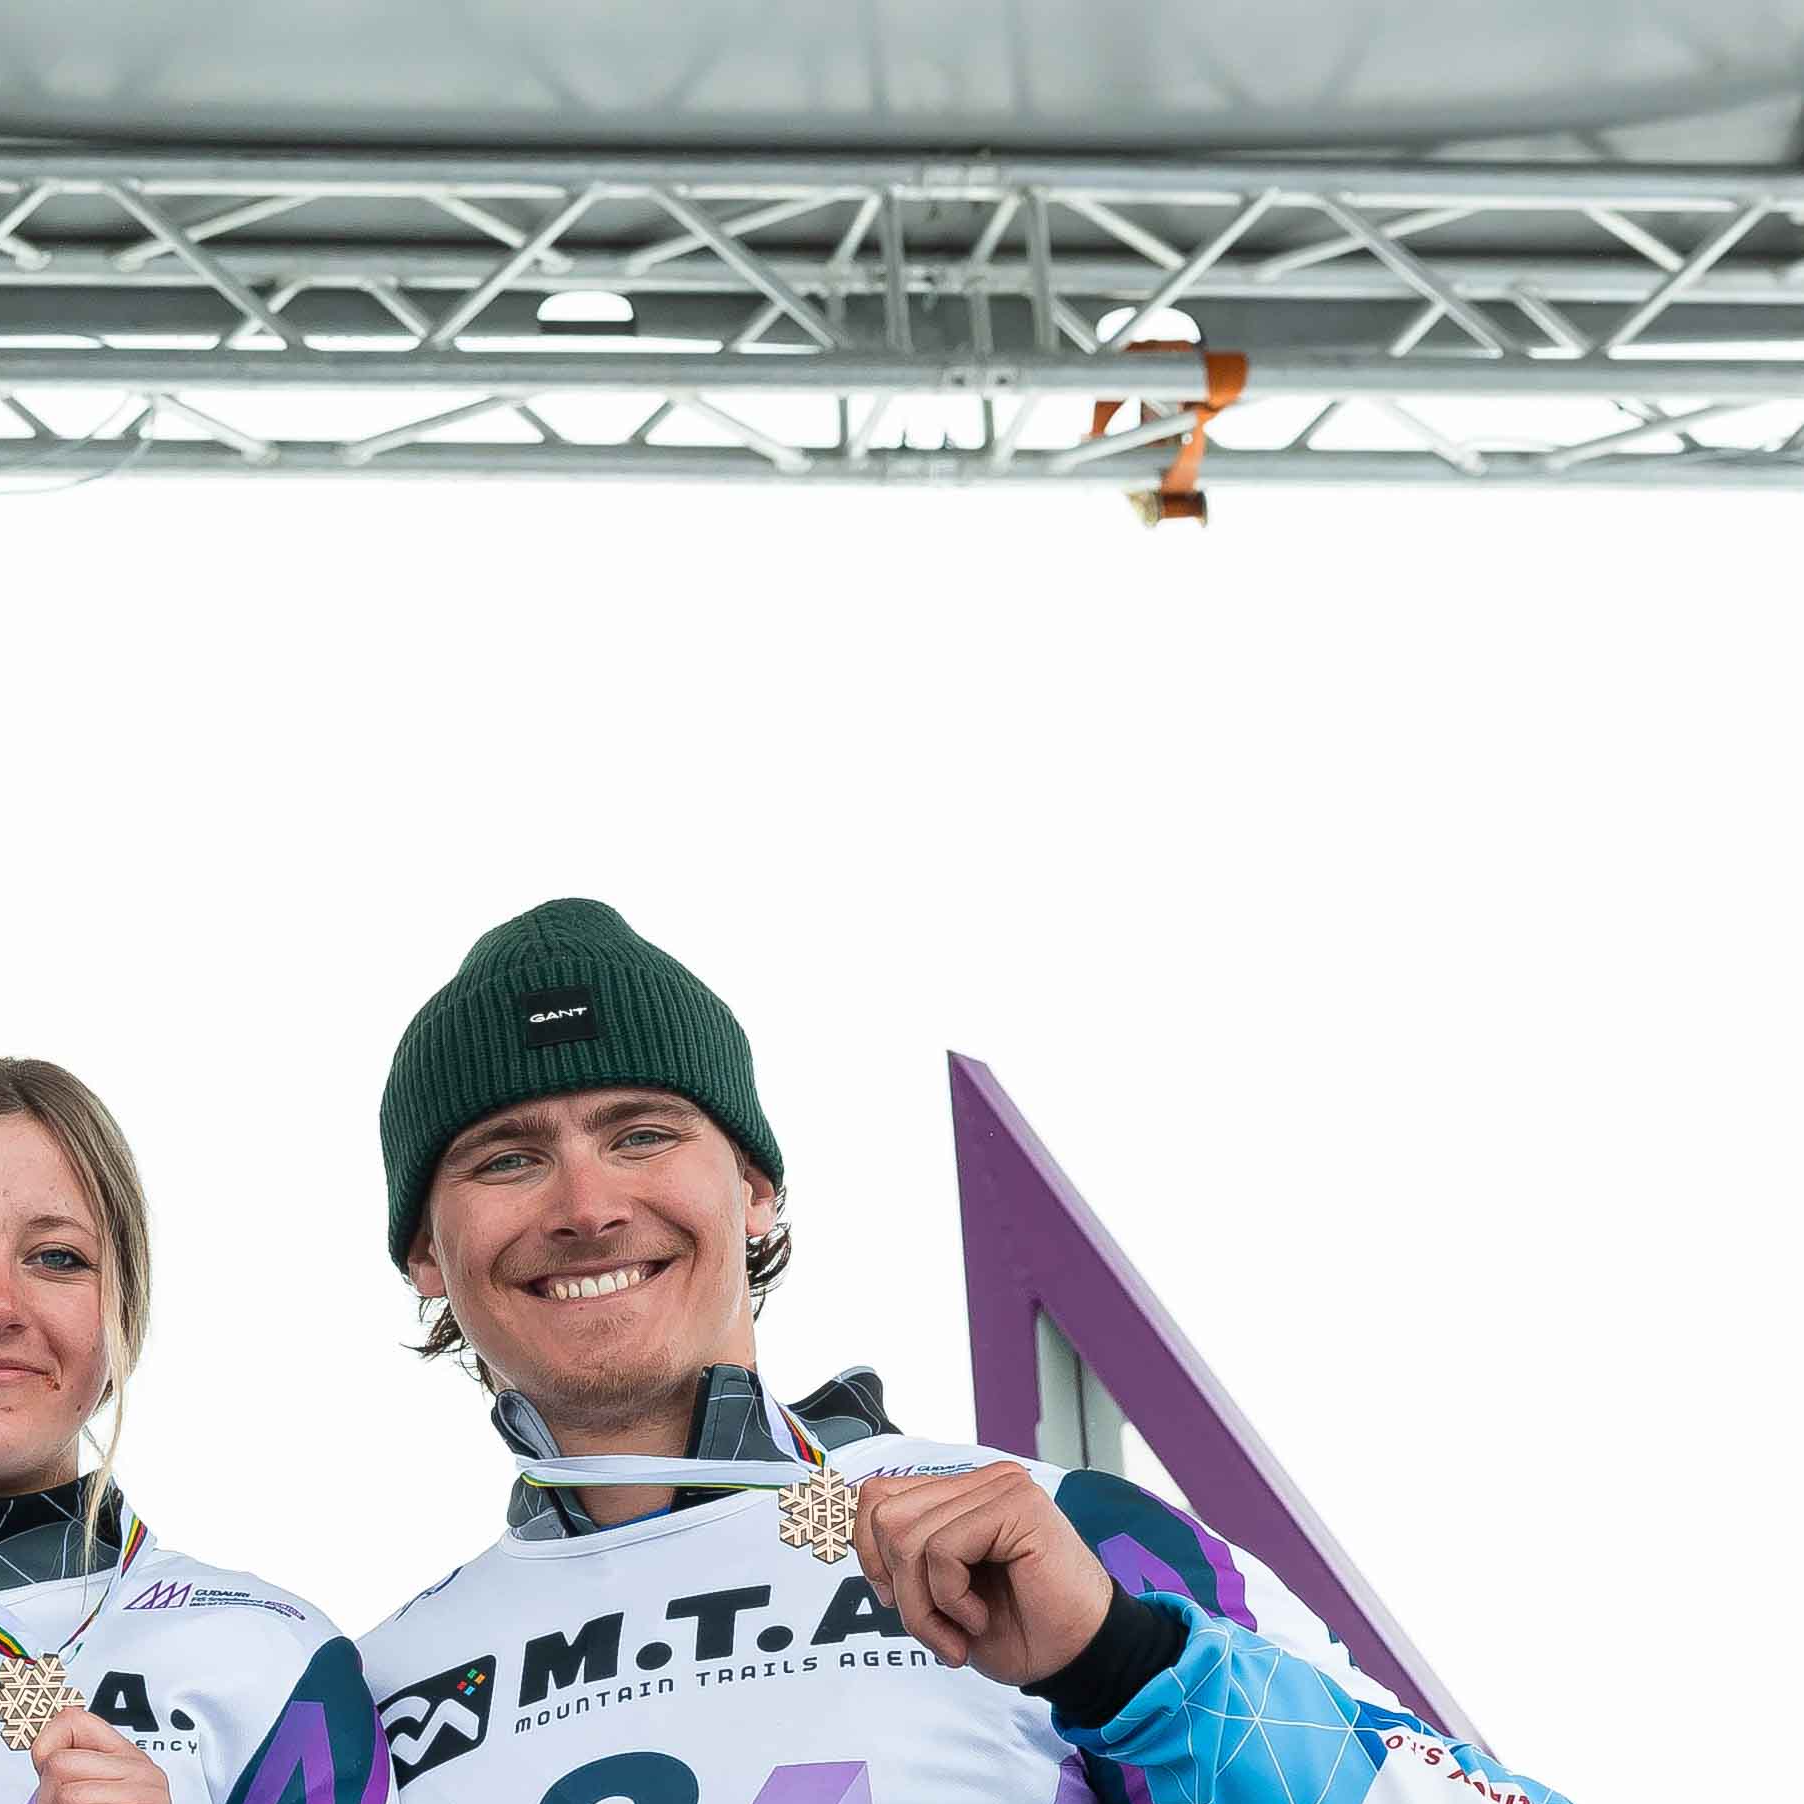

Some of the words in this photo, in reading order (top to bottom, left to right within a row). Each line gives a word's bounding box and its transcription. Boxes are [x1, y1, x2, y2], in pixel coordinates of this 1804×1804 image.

[529, 1006, 588, 1024] GANT
[518, 1574, 913, 1708] M.T.A
[514, 1678, 674, 1735] MOUNTAIN
[696, 1656, 819, 1687] TRAILS
[839, 1650, 945, 1668] AGEN
[136, 1739, 198, 1754] ENCY
